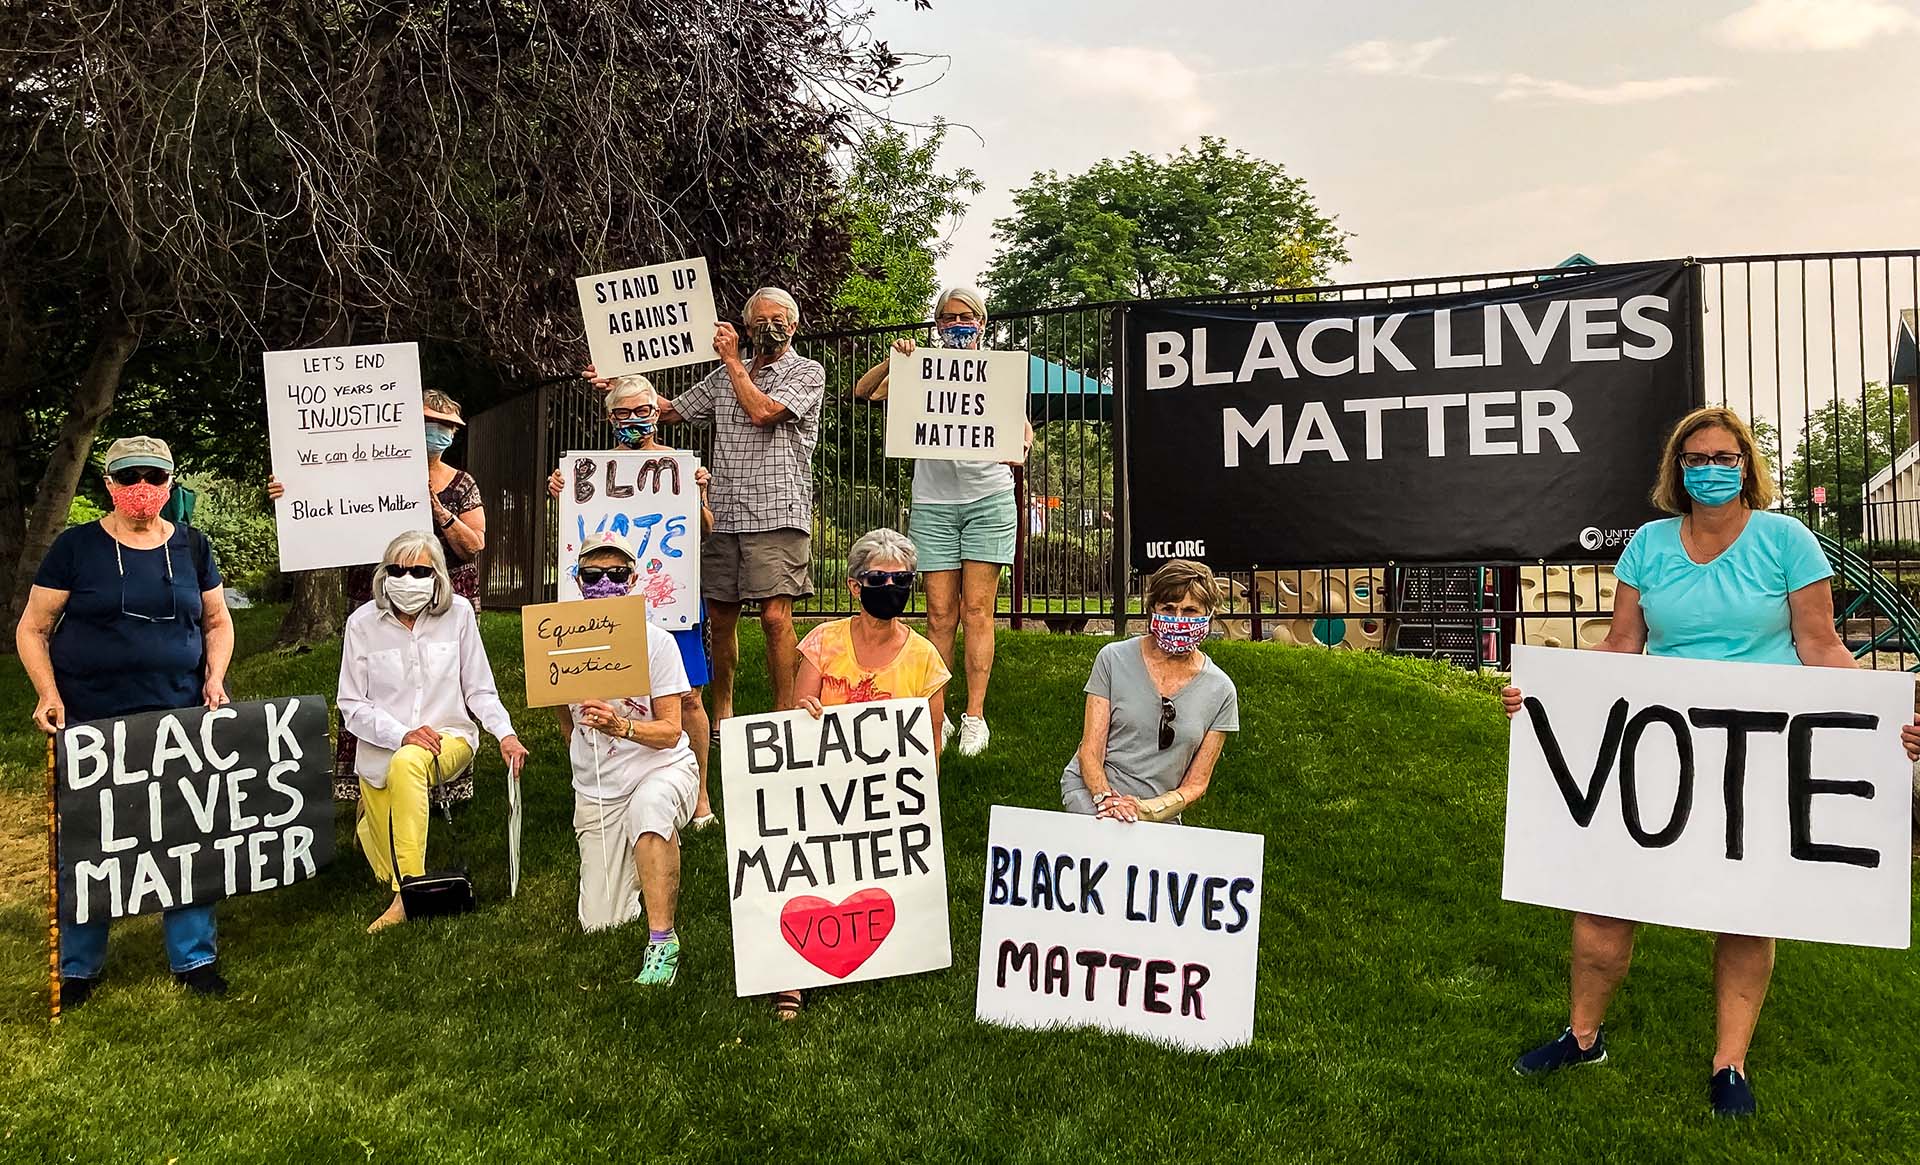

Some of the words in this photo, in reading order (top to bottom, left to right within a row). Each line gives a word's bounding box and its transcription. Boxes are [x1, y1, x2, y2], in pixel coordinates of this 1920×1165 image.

[594, 274, 660, 304] STAND
[672, 268, 697, 290] UP
[608, 301, 689, 335] AGAINST
[622, 331, 695, 363] RACISM
[1145, 312, 1417, 391] BLACK
[1433, 295, 1674, 369] LIVES
[303, 355, 345, 374] LET'S
[355, 353, 385, 369] END
[922, 357, 988, 382] BLACK
[287, 384, 327, 406] 400
[333, 383, 373, 397] YEARS
[379, 381, 397, 391] OF
[926, 390, 985, 416] LIVES
[297, 402, 405, 430] INJUSTICE
[1222, 389, 1581, 467] MATTER
[325, 451, 348, 462] can
[352, 443, 367, 460] do
[371, 443, 412, 458] better
[915, 422, 995, 448] MATTER
[573, 456, 681, 505] BLM
[290, 499, 334, 521] Black
[340, 498, 375, 515] Lives
[378, 494, 420, 513] Matter
[1146, 539, 1206, 559] UCC.ORG
[1604, 529, 1637, 538] UNITE
[537, 615, 622, 648] Equality
[549, 656, 633, 686] Justice
[64, 698, 304, 791] BLACK
[745, 705, 929, 774] BLACK
[1523, 696, 1881, 868] VOTE
[99, 759, 304, 853] LIVES
[756, 766, 926, 838] LIVES
[75, 825, 317, 925] MATTER
[732, 822, 931, 901] MATTER
[988, 846, 1110, 915] BLACK
[1125, 864, 1255, 934] LIVES
[782, 908, 885, 950] VOTE
[996, 938, 1211, 1020] MATTER
